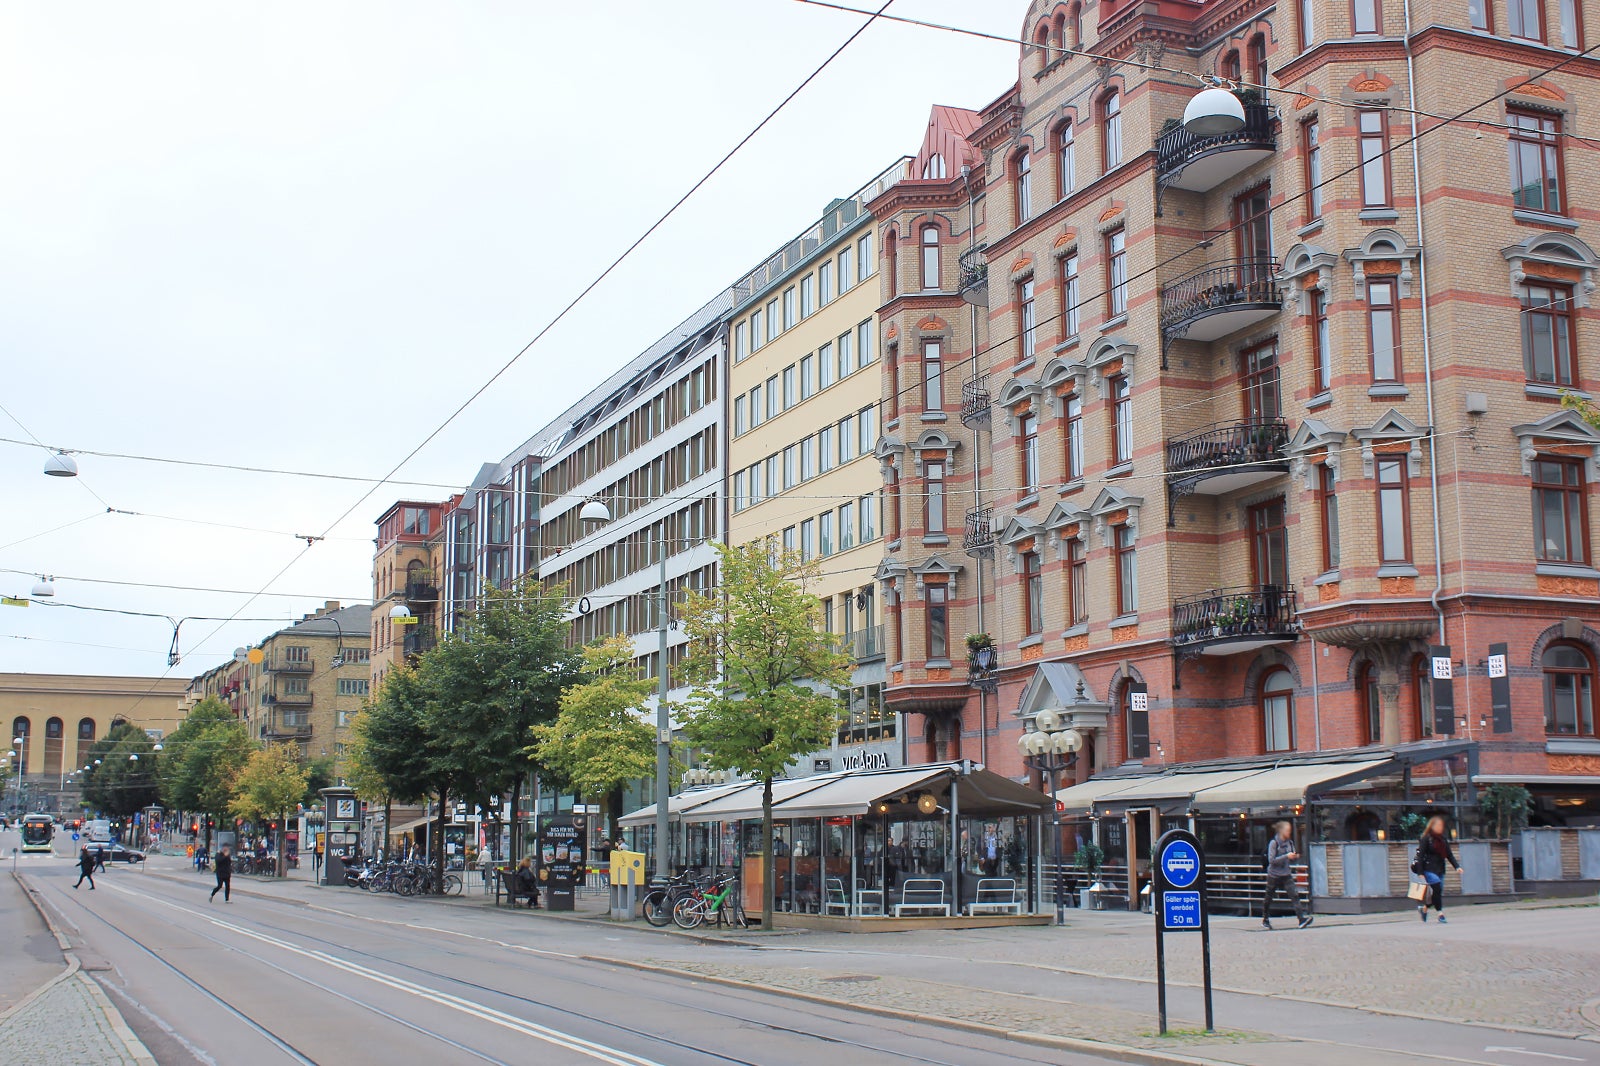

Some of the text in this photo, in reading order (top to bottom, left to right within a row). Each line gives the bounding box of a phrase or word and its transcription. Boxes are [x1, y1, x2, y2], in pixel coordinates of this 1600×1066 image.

[841, 750, 887, 770] VIGÅRDA
[330, 848, 344, 856] WC
[1173, 916, 1184, 924] 50
